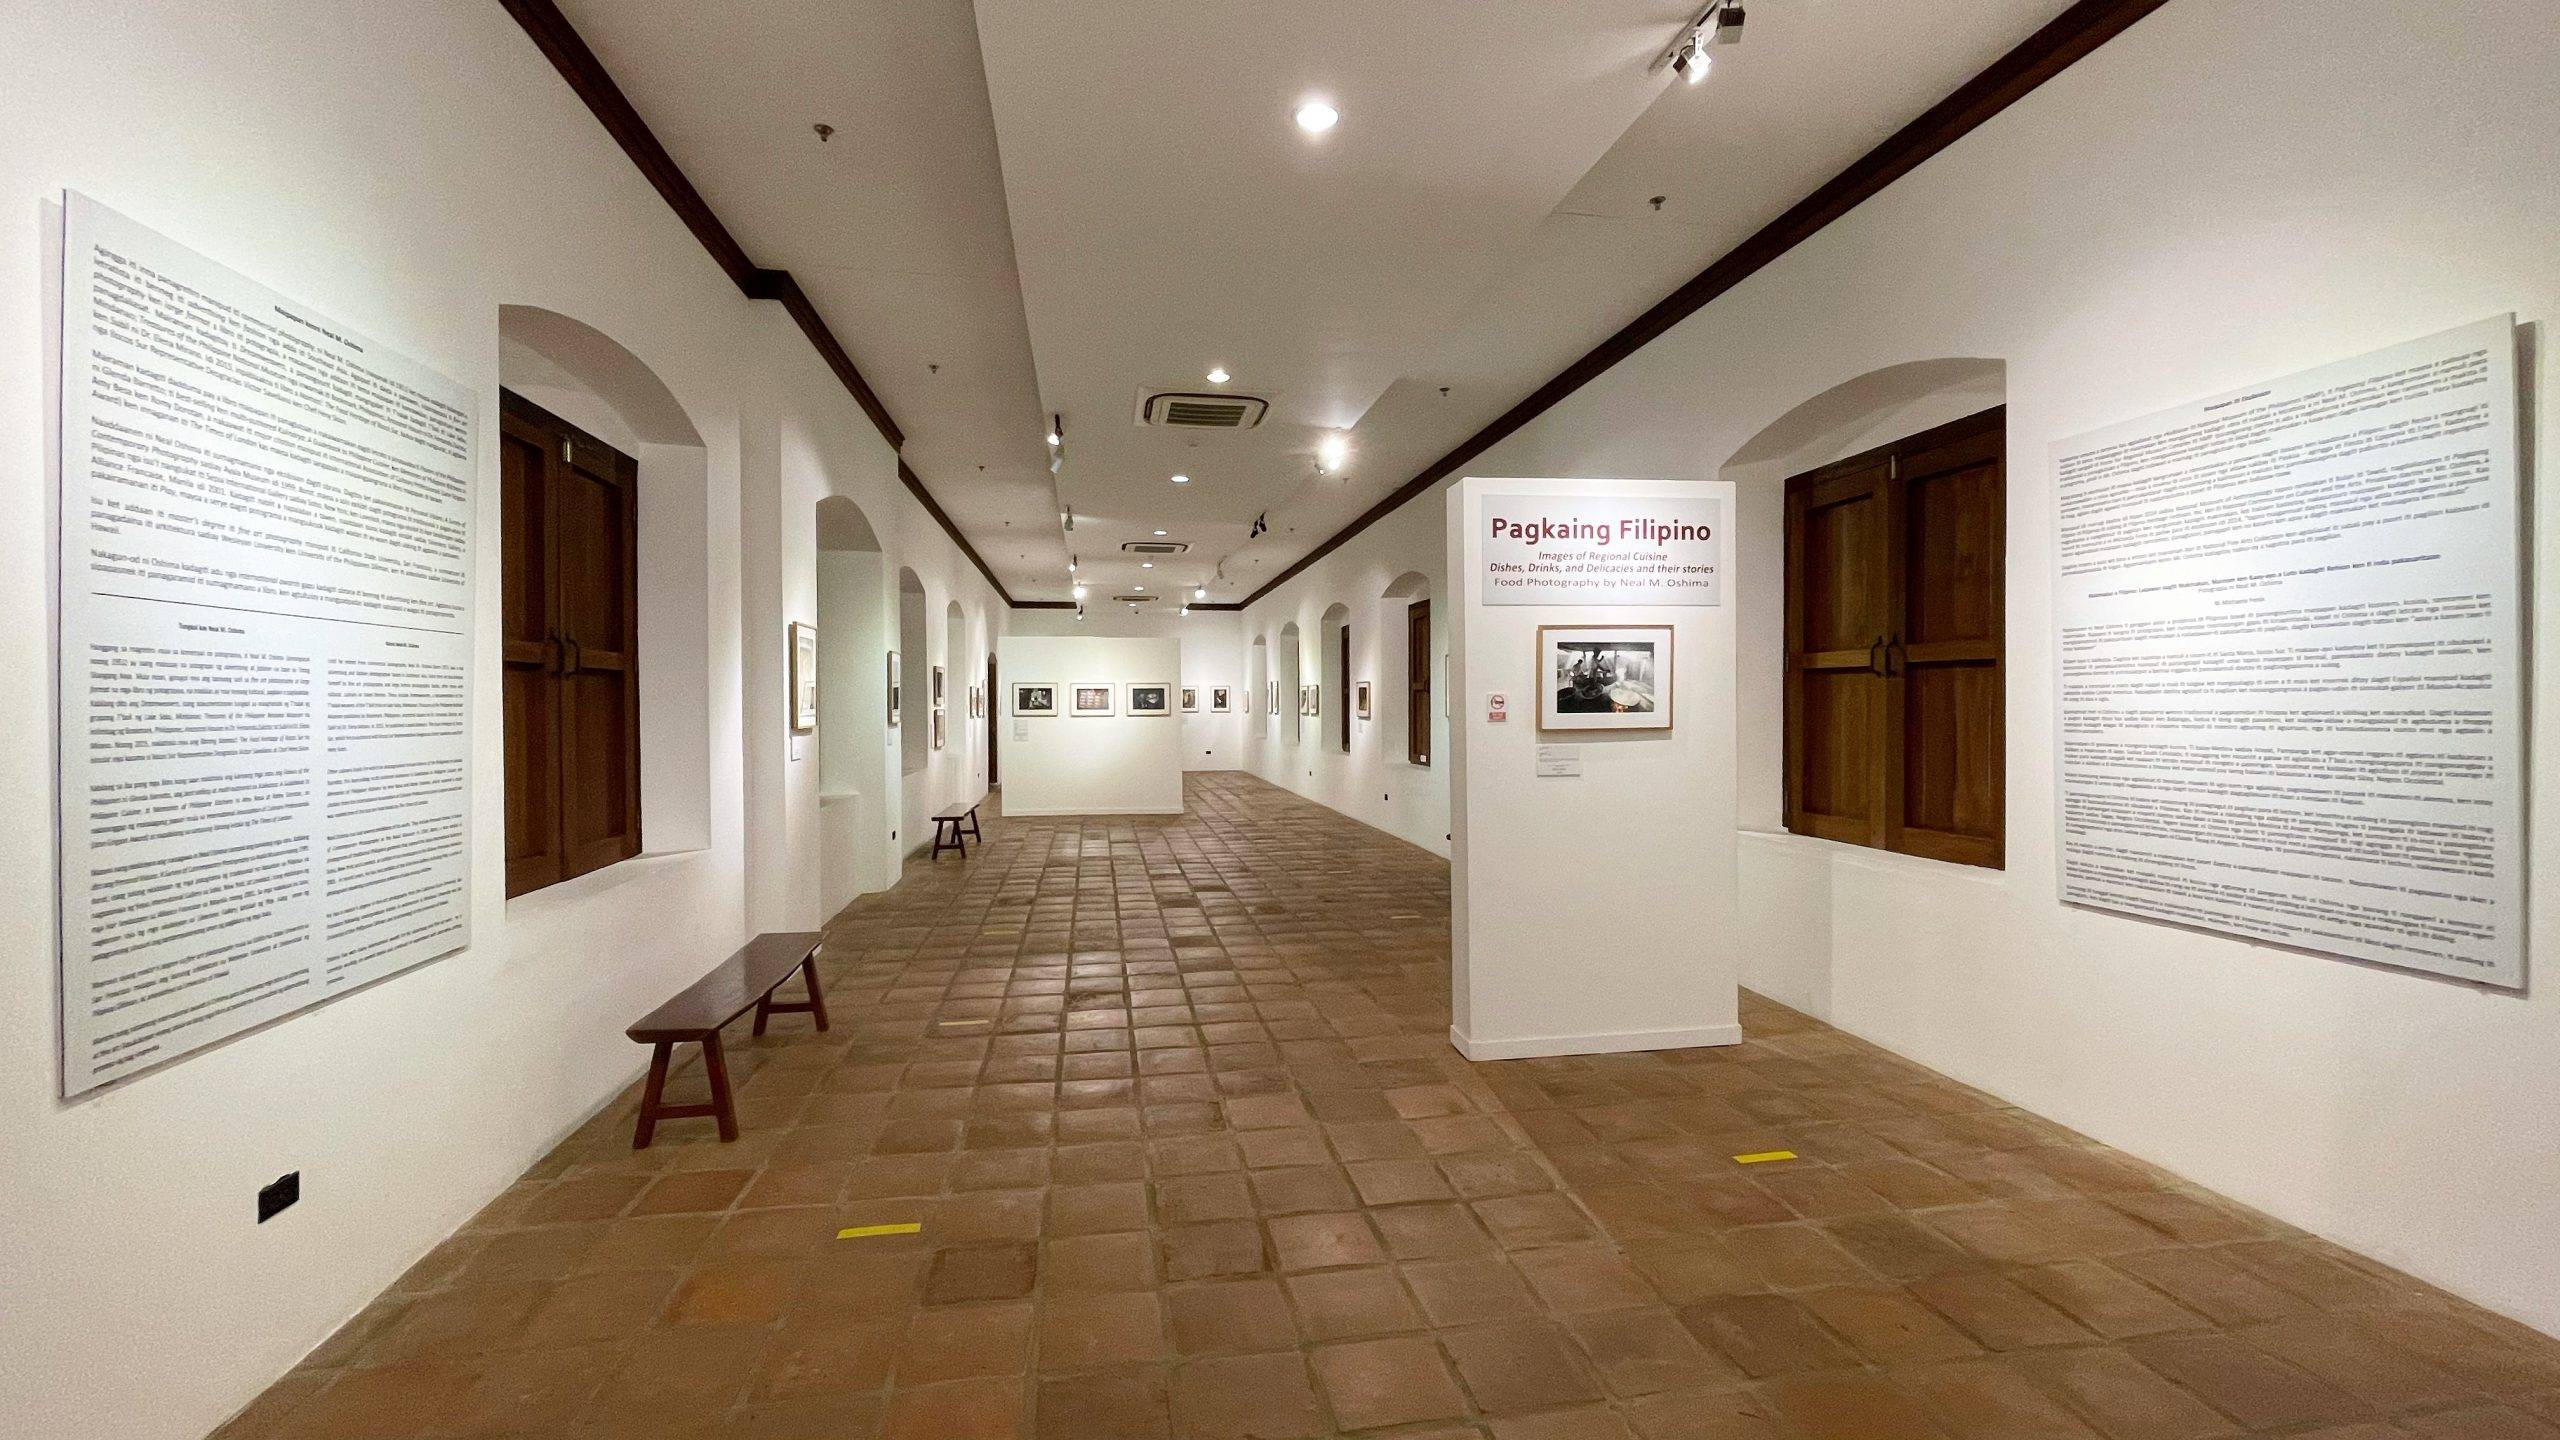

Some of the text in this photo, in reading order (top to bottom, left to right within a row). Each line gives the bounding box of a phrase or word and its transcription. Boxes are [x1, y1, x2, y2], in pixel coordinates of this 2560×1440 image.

[1492, 517, 1711, 546] Pagkaing Filipino
[1538, 551, 1668, 562] Images of Regional Cuisine
[1490, 563, 1714, 574] Dishes, Drinks, and Delicacies and their stories
[1495, 578, 1523, 587] Food
[1527, 578, 1599, 588] Photography
[1604, 579, 1616, 588] by
[1620, 579, 1645, 587] Neal
[1667, 578, 1709, 587] Oshima
